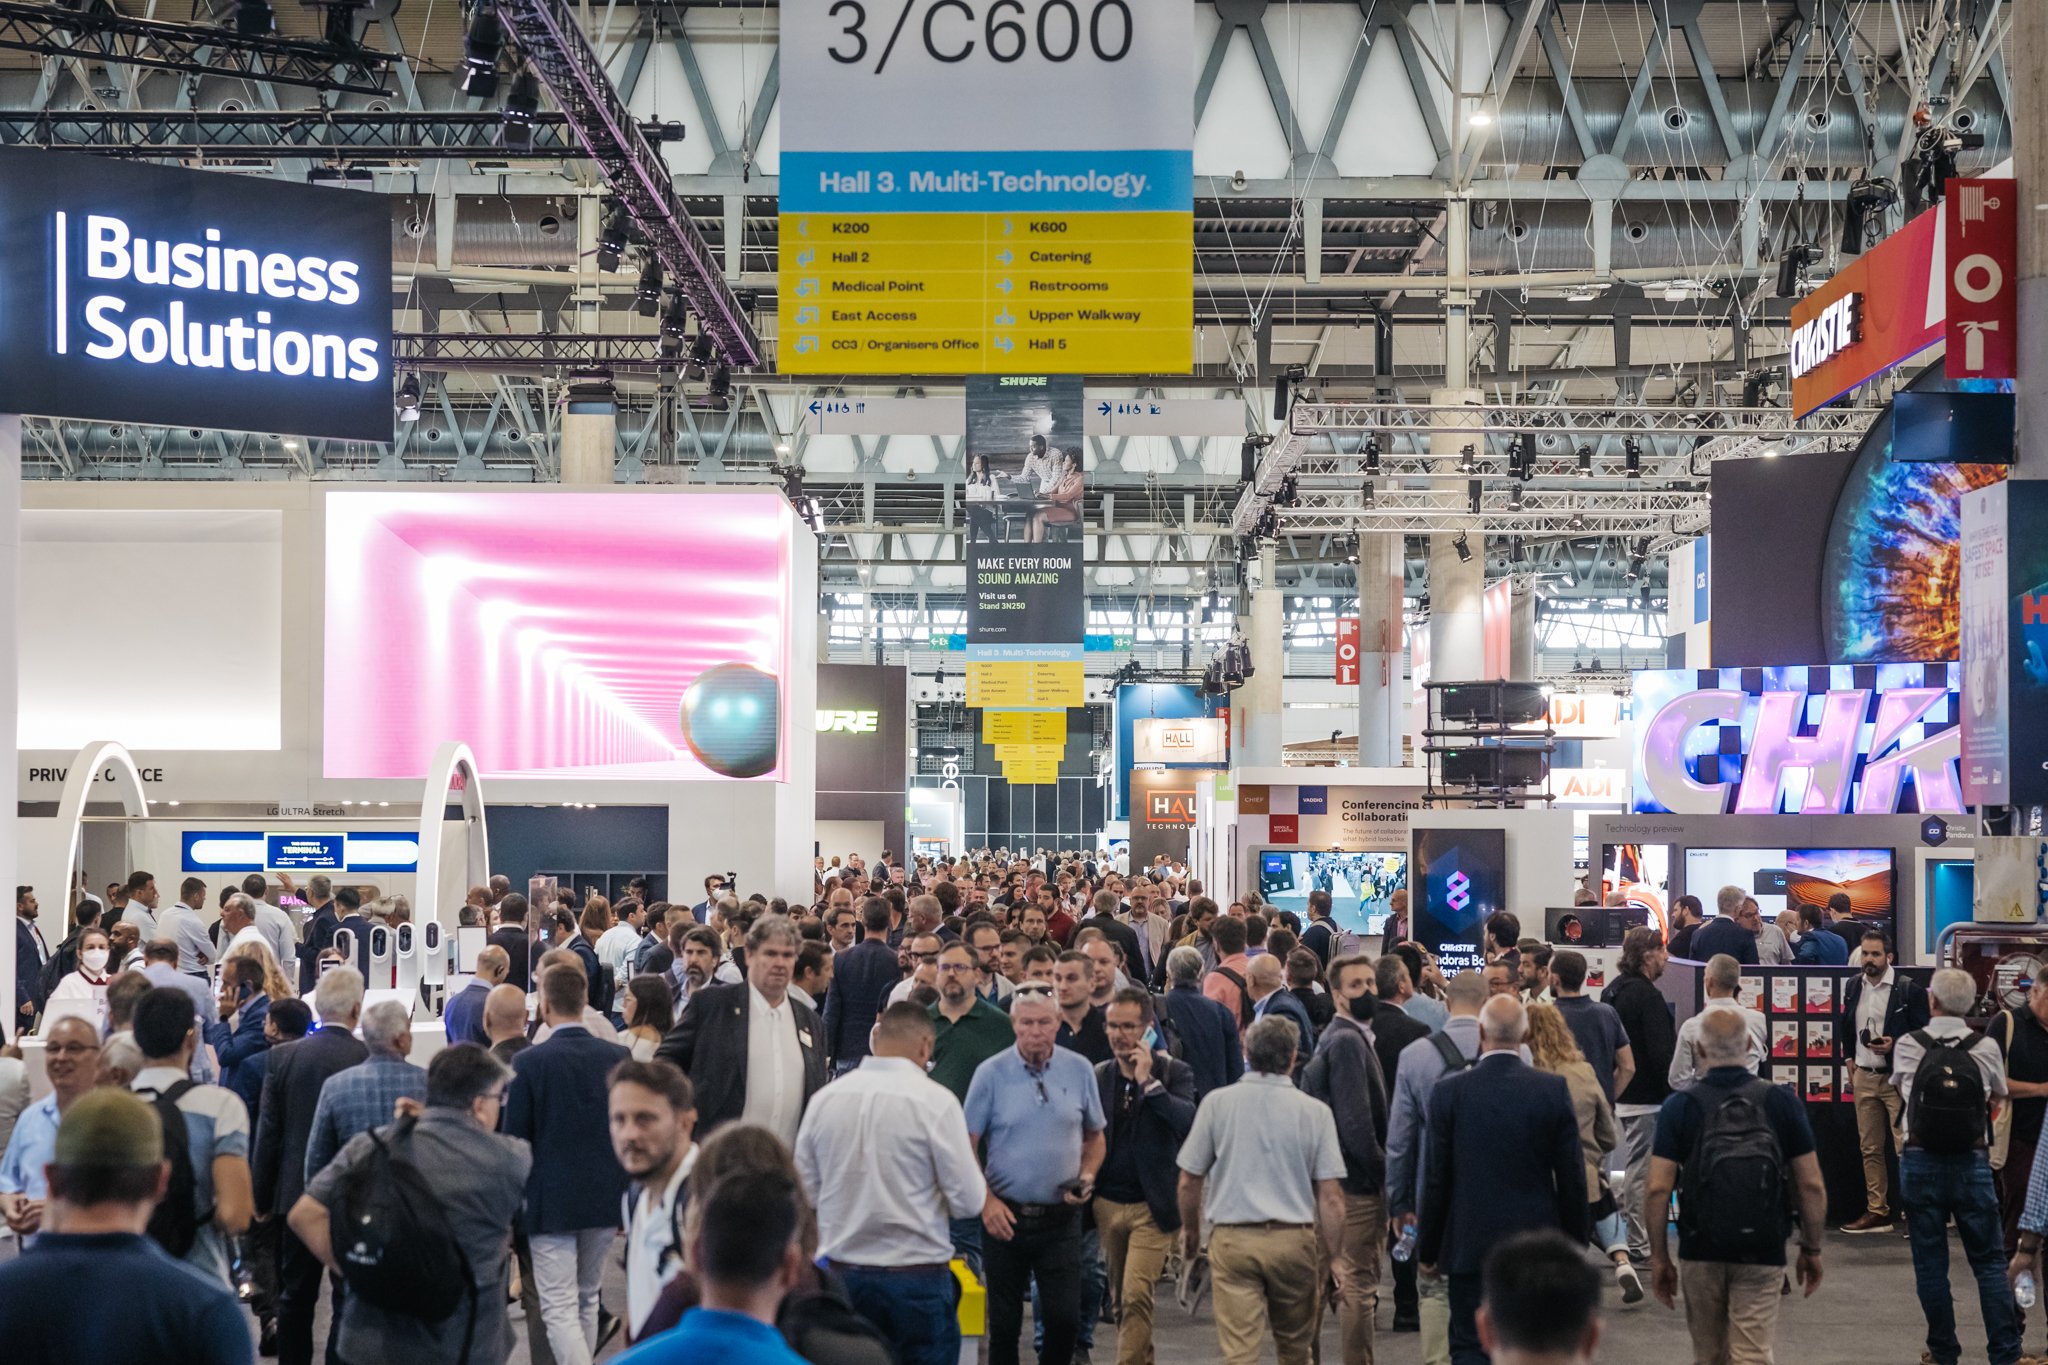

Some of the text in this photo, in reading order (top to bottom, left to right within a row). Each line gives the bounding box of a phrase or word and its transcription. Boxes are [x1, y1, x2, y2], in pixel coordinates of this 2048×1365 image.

[827, 0, 1134, 75] 3/C600
[819, 171, 870, 193] Hall
[909, 170, 1151, 198] Multi-Technology.
[832, 222, 870, 234] K200
[1029, 222, 1067, 233] K600
[87, 214, 360, 305] Business
[832, 251, 870, 263] Hall 2
[1029, 250, 1092, 265] Catering
[832, 280, 925, 292] Medical Point
[1029, 280, 1109, 292] Restrooms
[832, 310, 917, 322] East Access
[1029, 309, 1141, 323] Upper Walkway
[85, 295, 380, 382] Solutions
[1791, 292, 1853, 379] CHRISTIE
[832, 339, 858, 350] CC3
[868, 339, 939, 353] Organisers
[942, 339, 980, 350] Office
[1029, 339, 1067, 350] Hall 5
[1000, 377, 1047, 386] SHURE
[977, 558, 1072, 570] MAKE EVERY ROOM
[978, 572, 1059, 585] SOUND AMAZING
[979, 592, 996, 600] Visit
[979, 602, 1026, 610] Stand 3N250
[816, 710, 879, 734] URE
[1165, 733, 1191, 744] HALL
[29, 768, 163, 782] PRIV OICE
[1563, 776, 1612, 796] ADI
[1154, 797, 1196, 814] HAL
[1342, 800, 1419, 810] Conferencing
[267, 807, 345, 816] LG ULTRA Stretch
[1342, 812, 1408, 821] Collaborati
[1605, 823, 1685, 834] Technology preview
[1946, 832, 1975, 840] Pandoras
[282, 846, 329, 854] TERMINAL 7
[1439, 943, 1476, 952] CHRISTIE
[1436, 953, 1485, 966] ndoras Bo
[1440, 966, 1461, 978] ersi
